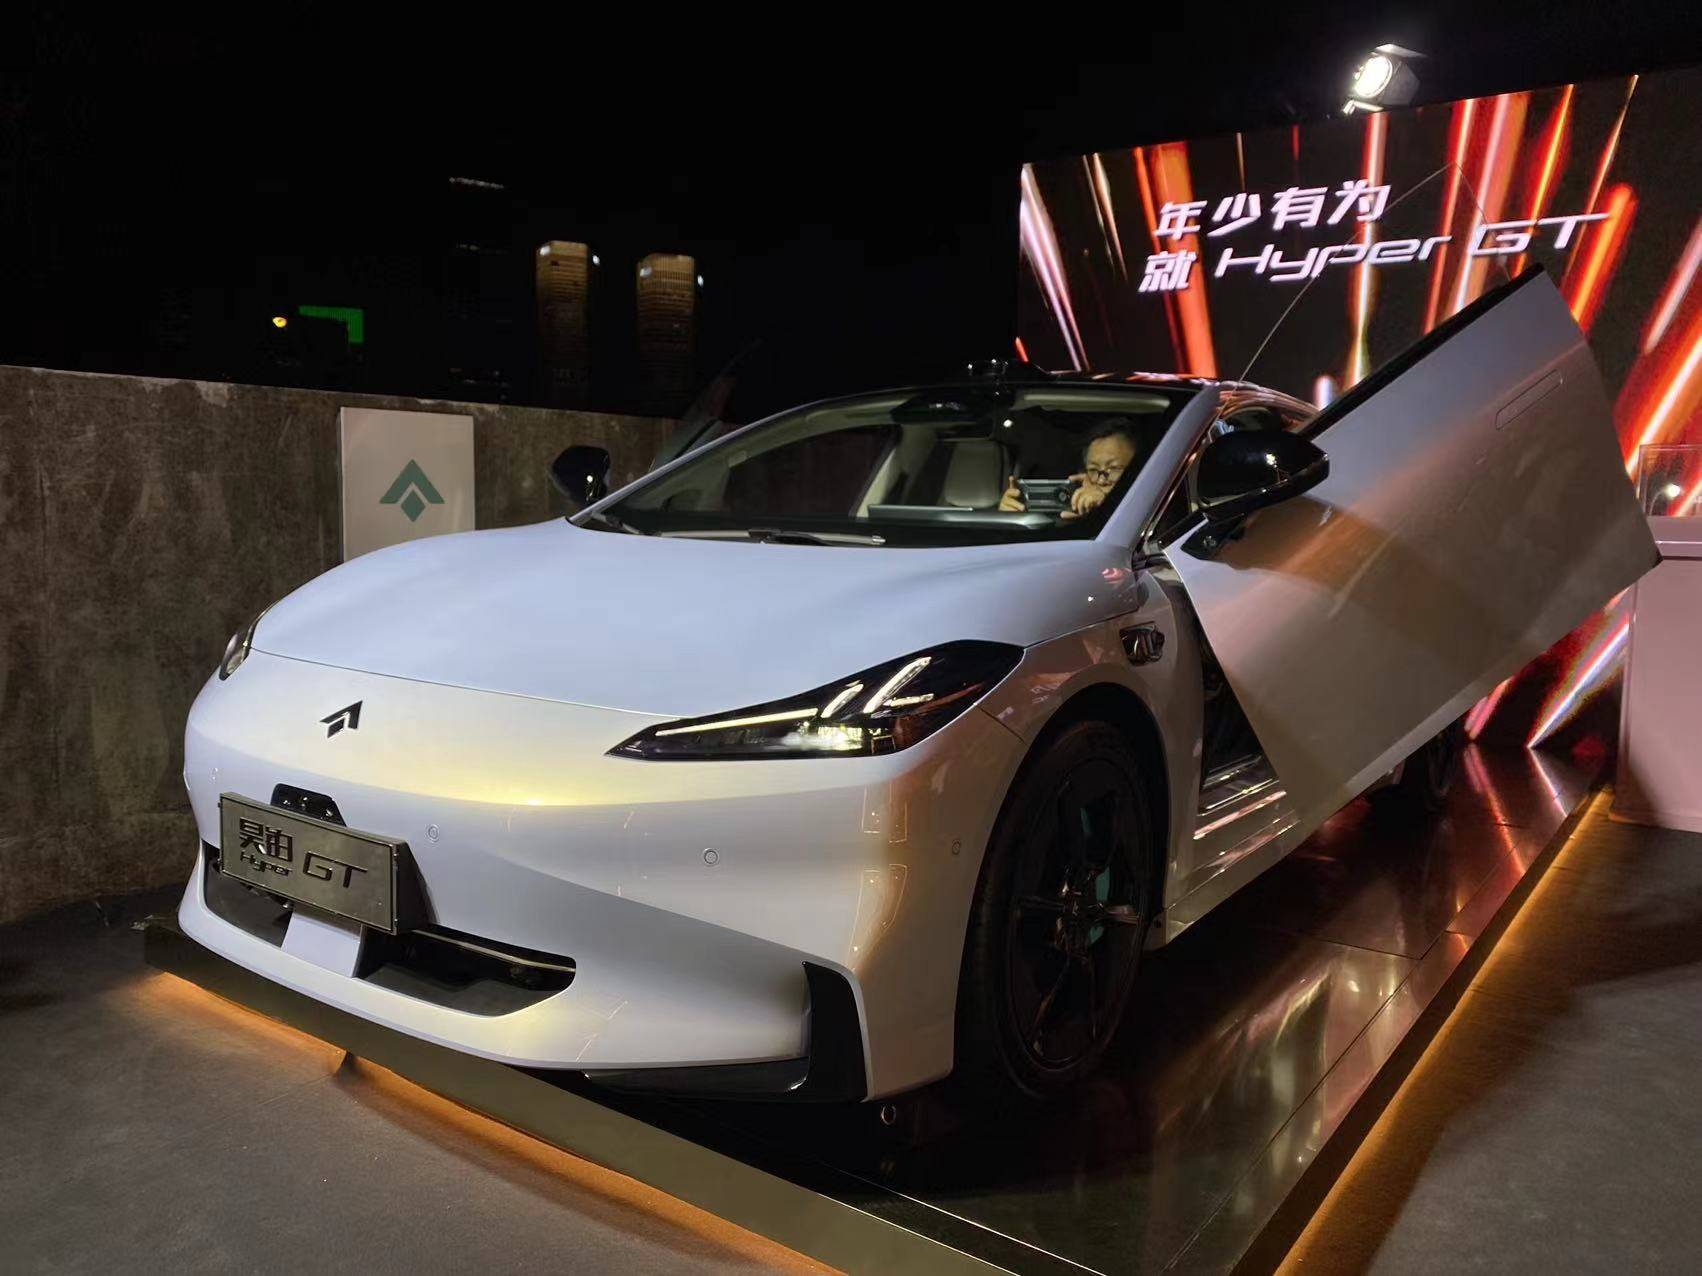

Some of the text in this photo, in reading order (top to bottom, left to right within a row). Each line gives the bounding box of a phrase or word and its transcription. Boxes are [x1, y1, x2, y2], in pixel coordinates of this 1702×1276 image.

[1155, 180, 1391, 240] 年少有为
[1138, 213, 1609, 293] 就 Hyper GT
[240, 851, 292, 876] Hyper
[303, 851, 368, 888] GT
